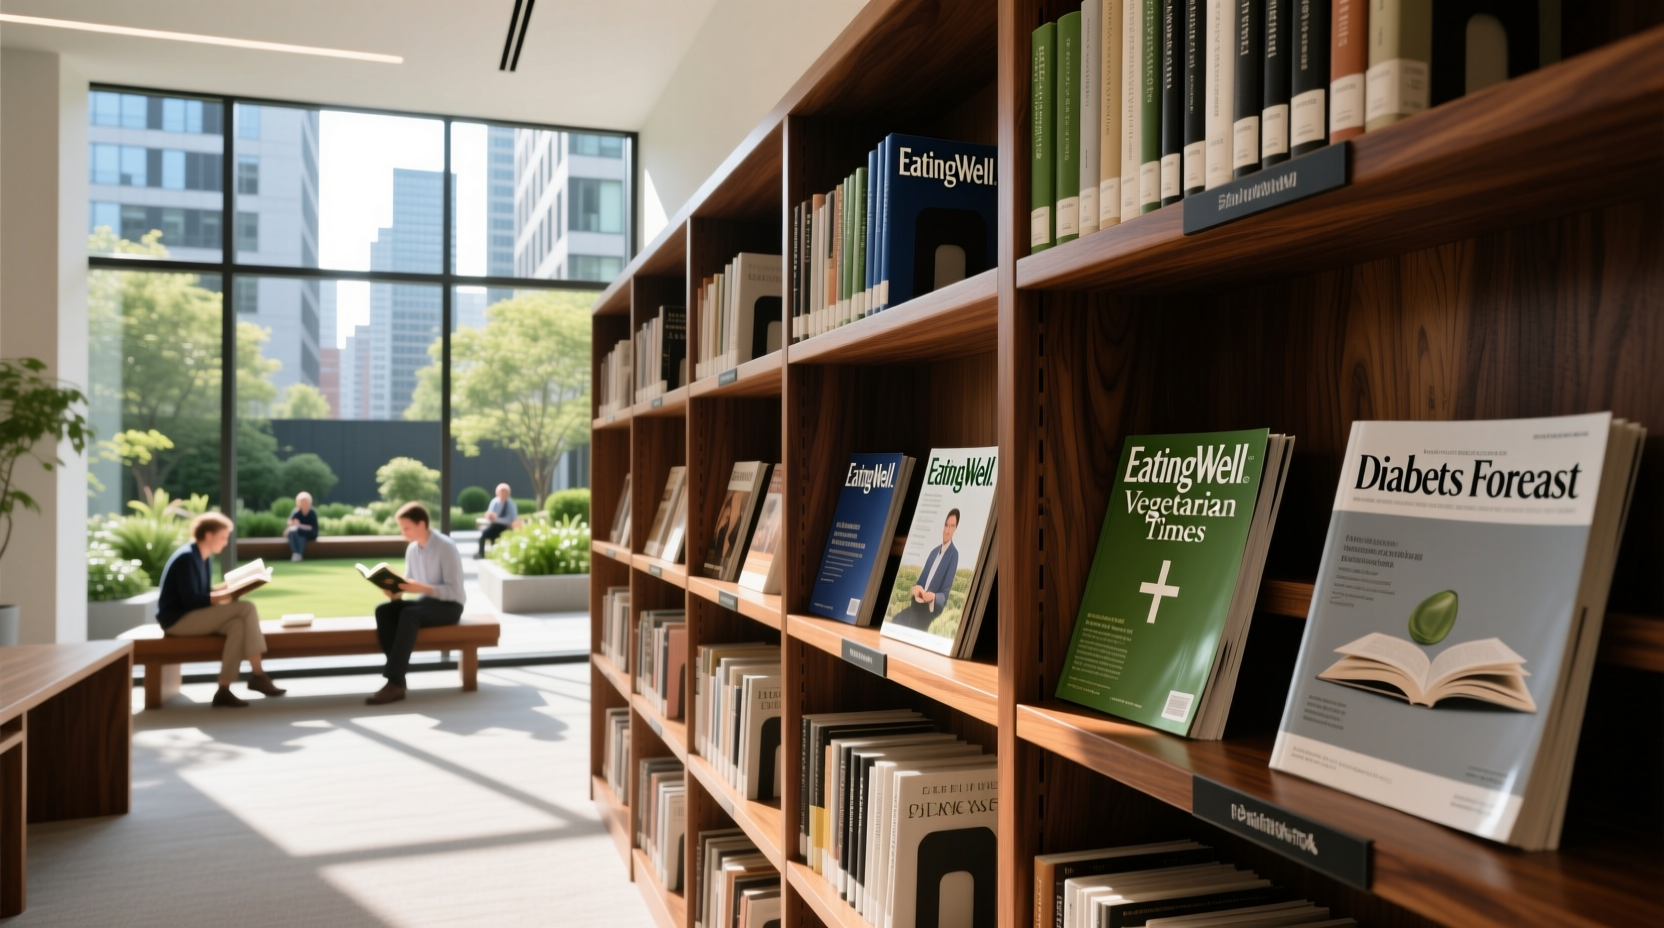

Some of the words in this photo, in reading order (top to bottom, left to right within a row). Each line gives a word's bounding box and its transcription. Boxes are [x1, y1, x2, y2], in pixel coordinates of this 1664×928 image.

[1354, 454, 1464, 497] Diabets
[1468, 459, 1583, 499] Foreast
[1125, 490, 1237, 520] Vegetarian
[1145, 517, 1206, 543] Times
